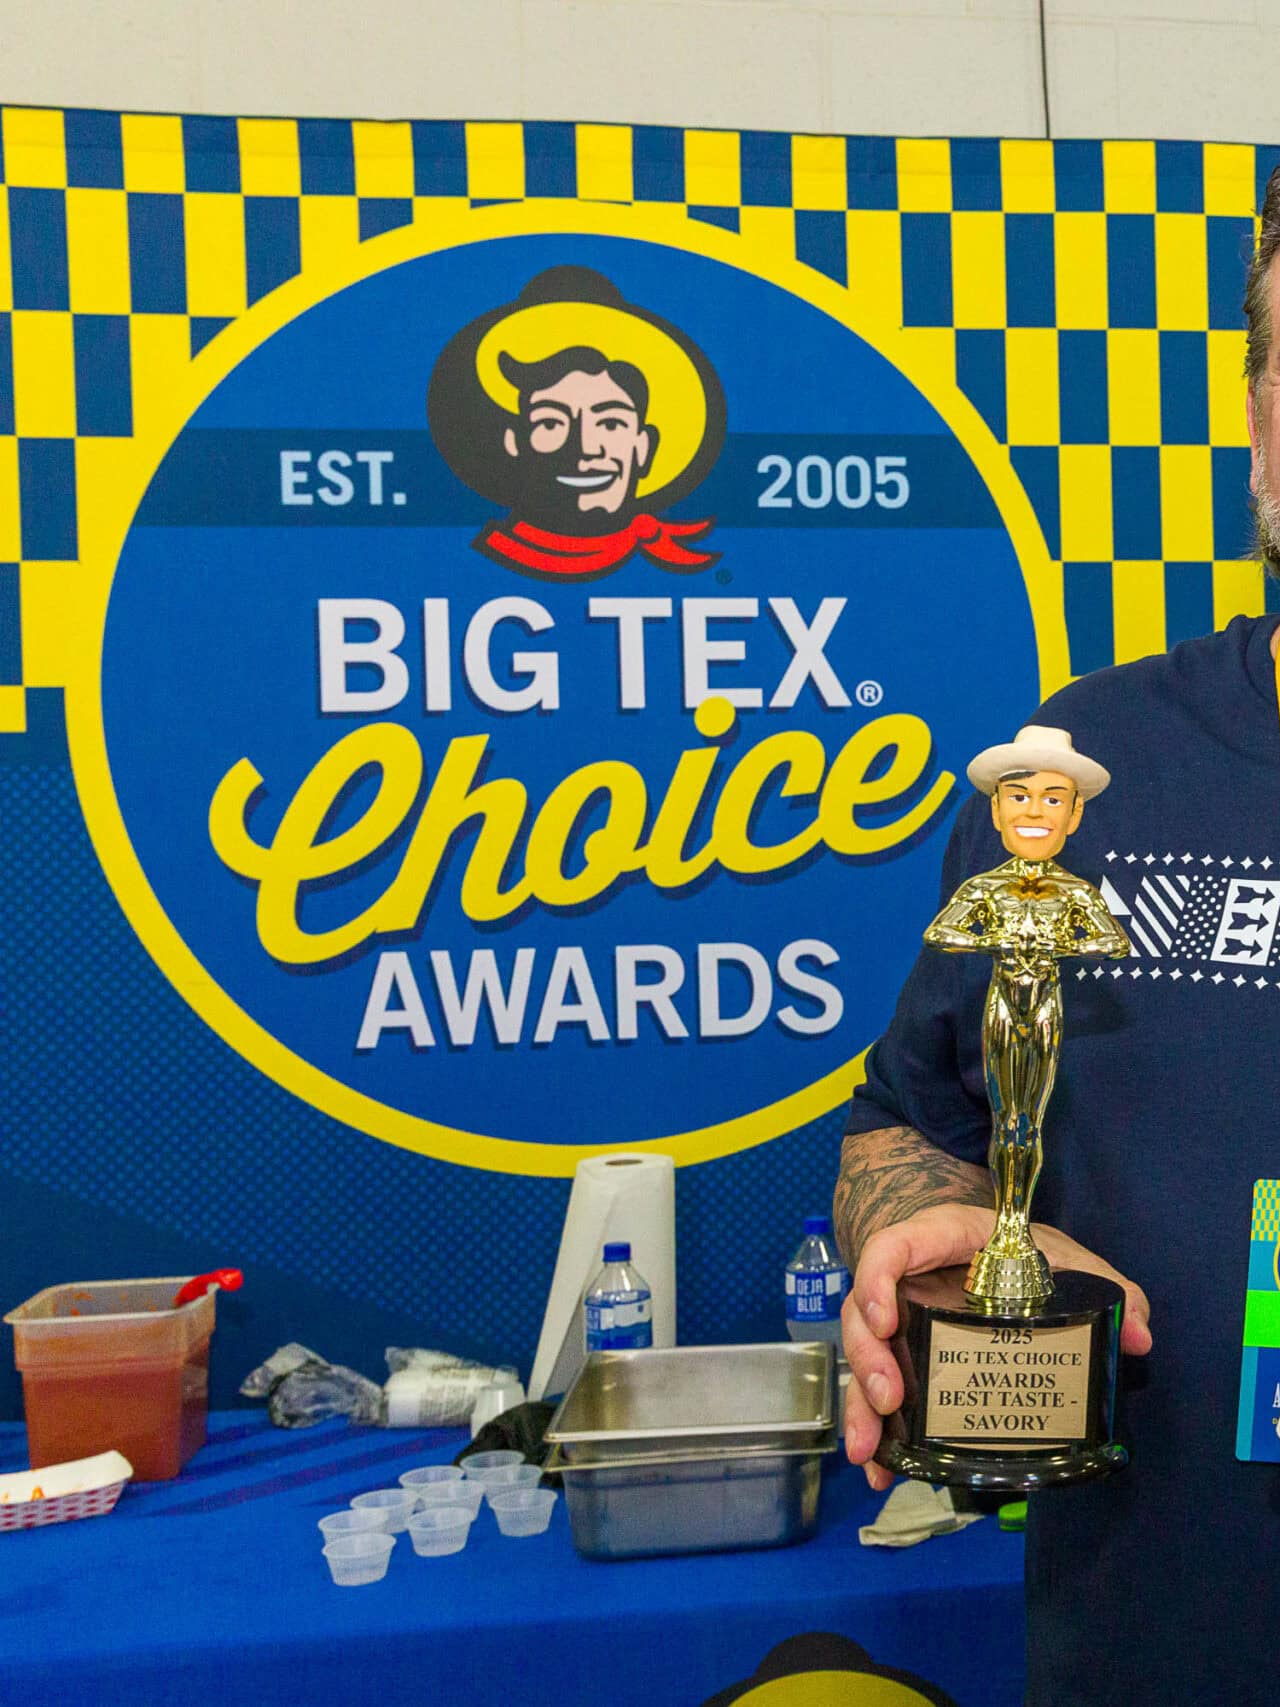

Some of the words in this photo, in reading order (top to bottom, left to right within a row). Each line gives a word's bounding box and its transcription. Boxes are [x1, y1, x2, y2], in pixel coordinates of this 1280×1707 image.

[279, 450, 407, 505] EST.
[756, 455, 910, 508] 2005
[317, 595, 561, 713] BIG
[208, 696, 956, 965] Choice
[355, 939, 844, 1050] AWARDS
[797, 1295, 824, 1312] BLUE
[990, 1329, 1033, 1344] 2025
[938, 1350, 969, 1364] BIG
[973, 1351, 1008, 1365] TEX
[1013, 1353, 1082, 1366] CHOICE
[966, 1372, 1056, 1389] AWARDS
[938, 1391, 993, 1406] BEST
[997, 1392, 1065, 1408] TASTE
[963, 1414, 1050, 1431] SAVORY
